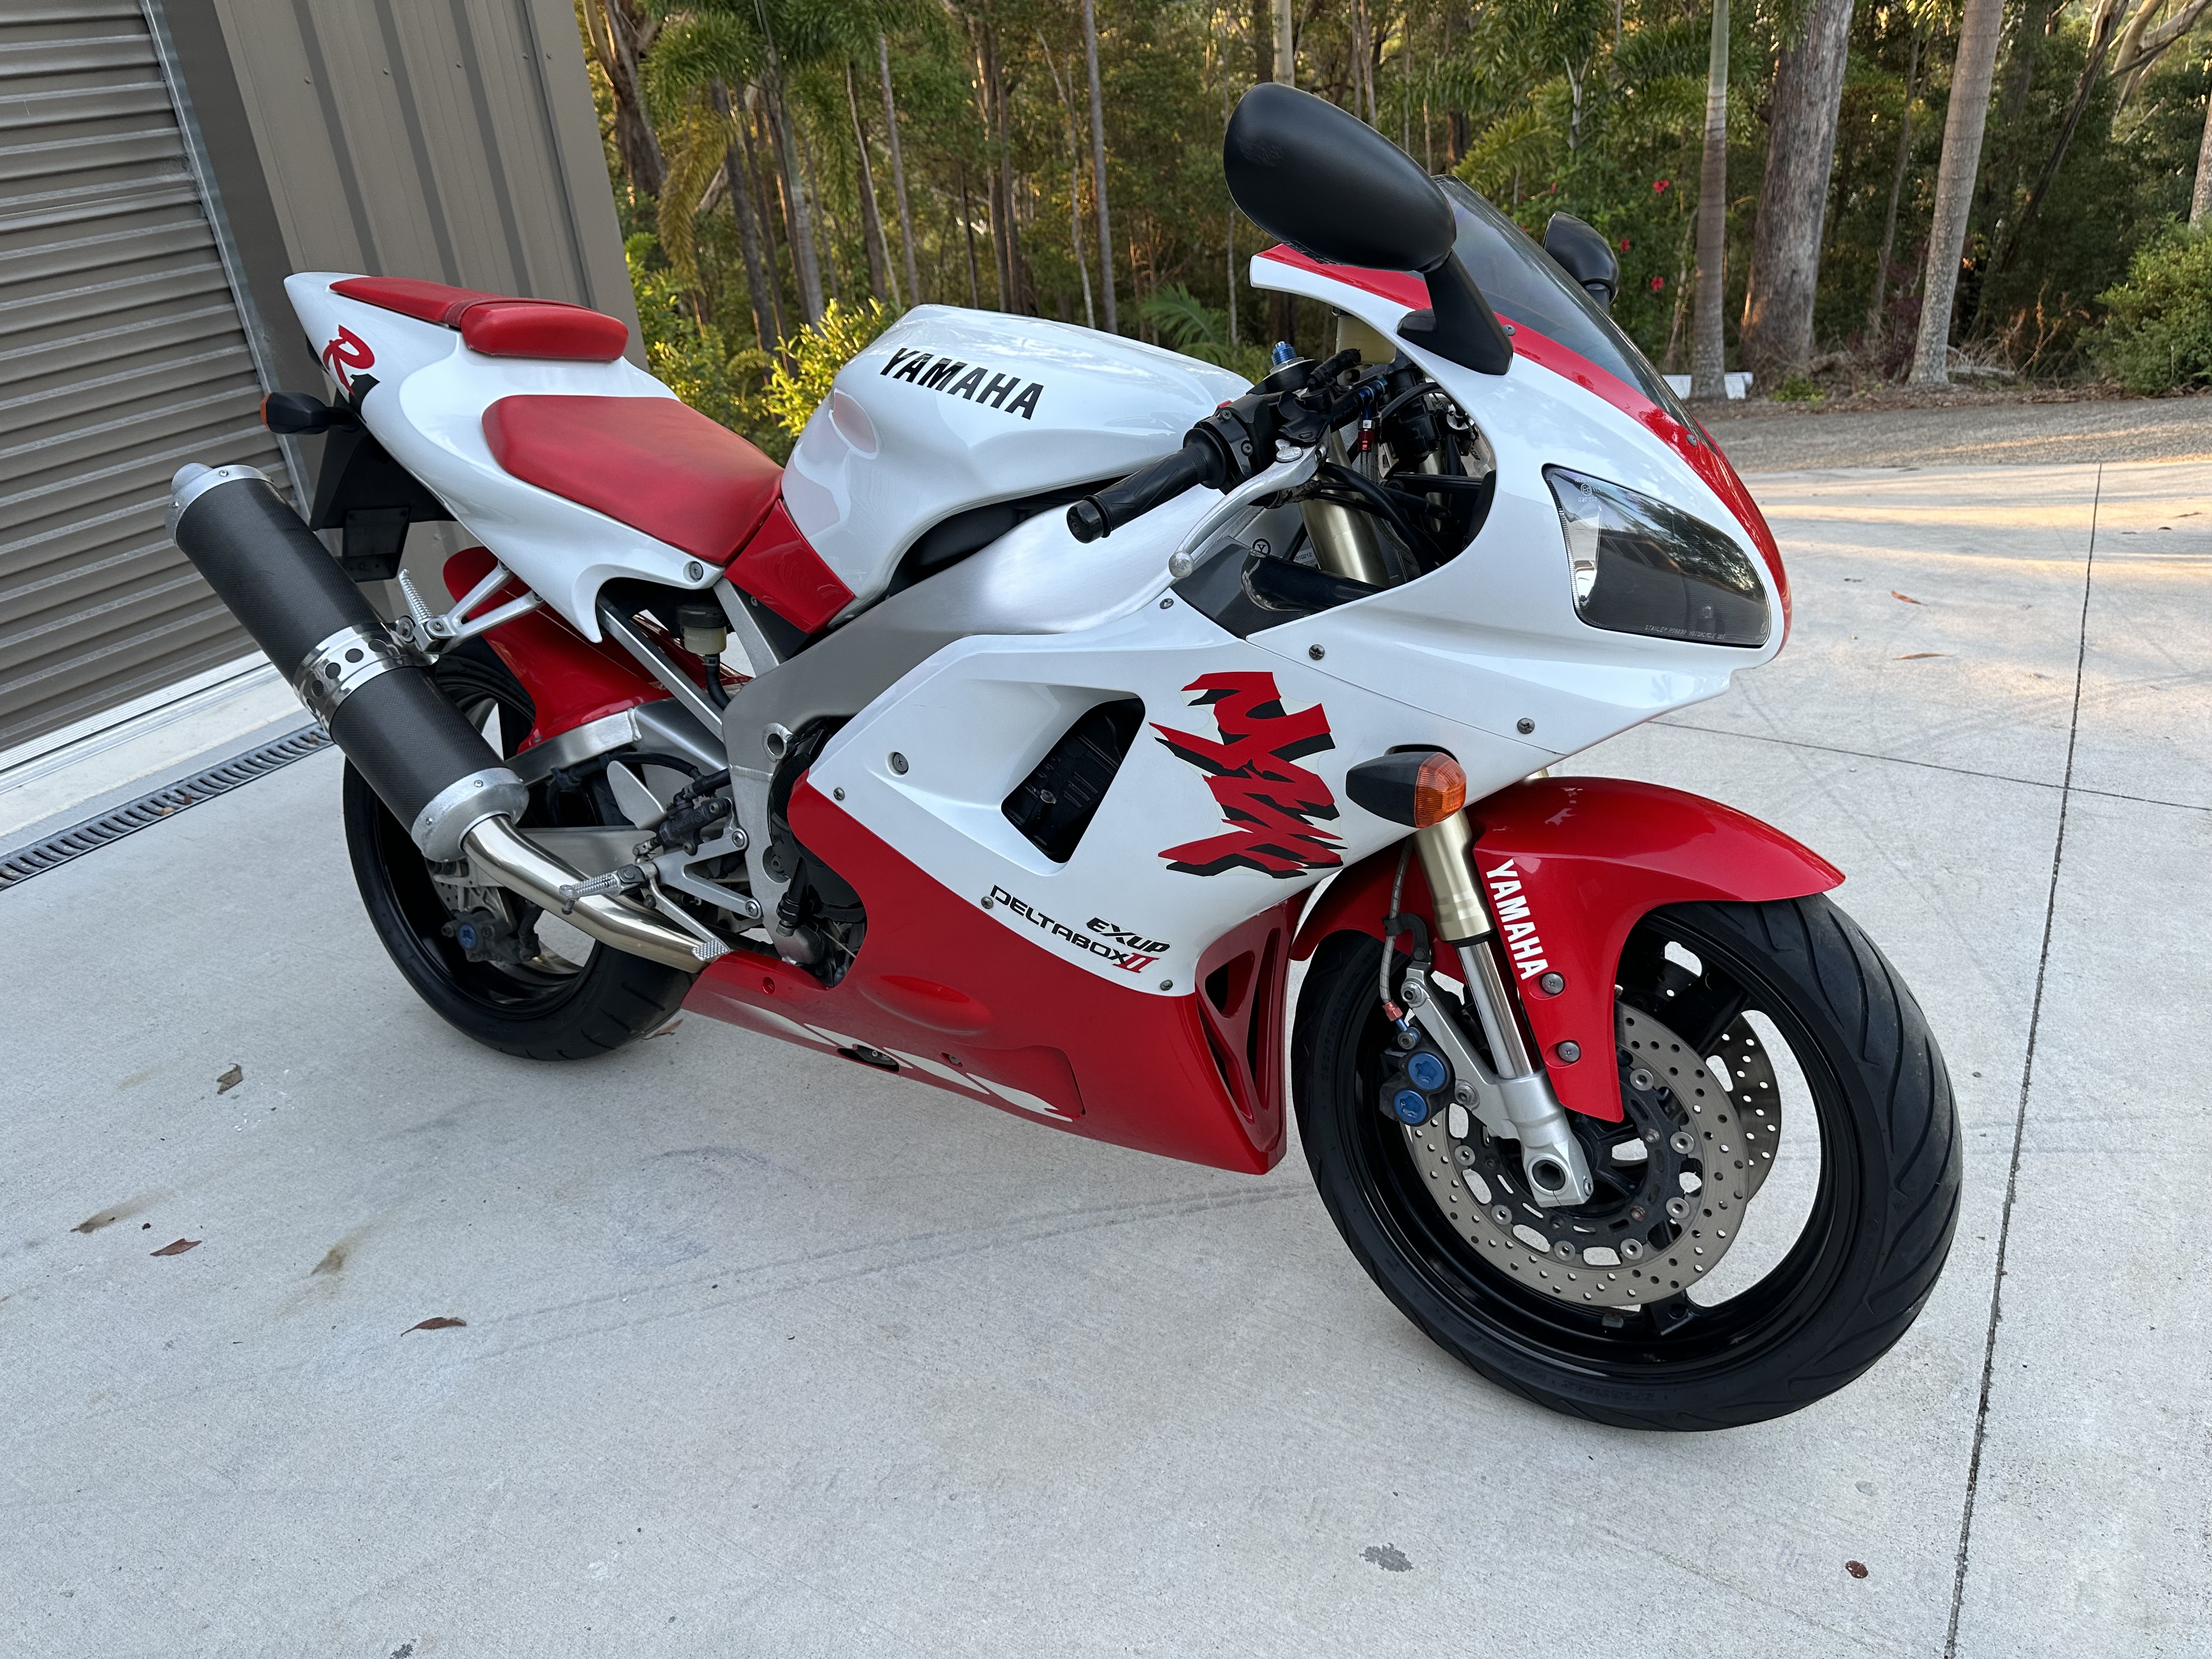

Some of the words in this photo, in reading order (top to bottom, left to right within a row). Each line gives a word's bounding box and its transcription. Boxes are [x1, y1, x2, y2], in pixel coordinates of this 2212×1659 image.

[323, 324, 380, 424] R1
[880, 348, 1044, 420] YAMAHA
[1086, 917, 1171, 953] EXUP
[1486, 859, 1549, 980] YAMAHA
